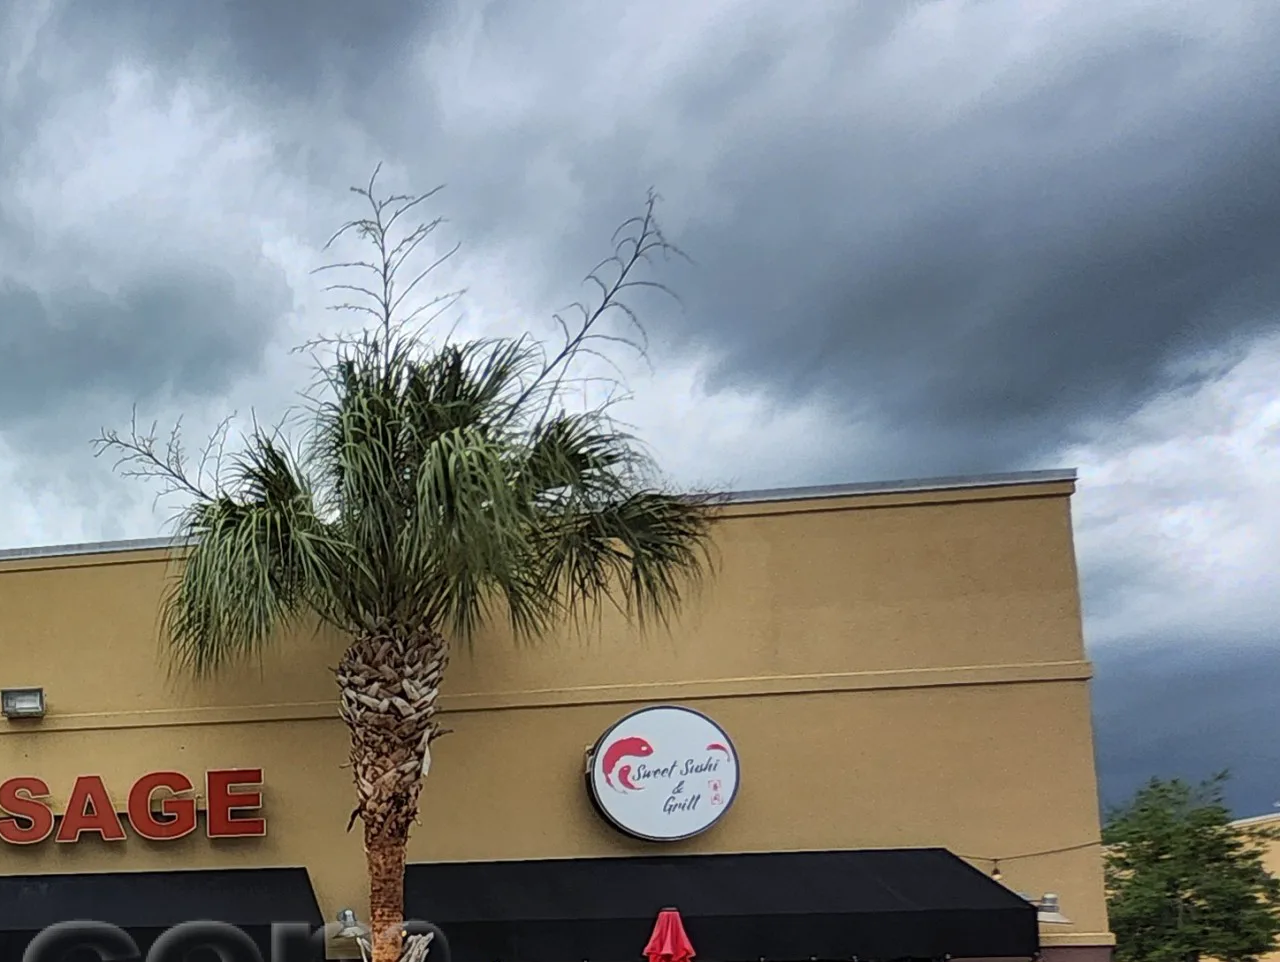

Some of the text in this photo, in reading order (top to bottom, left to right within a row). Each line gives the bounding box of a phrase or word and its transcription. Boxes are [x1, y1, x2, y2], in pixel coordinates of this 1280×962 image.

[632, 757, 721, 782] Sweet Sushi
[671, 780, 685, 795] &
[662, 794, 701, 815] Grill
